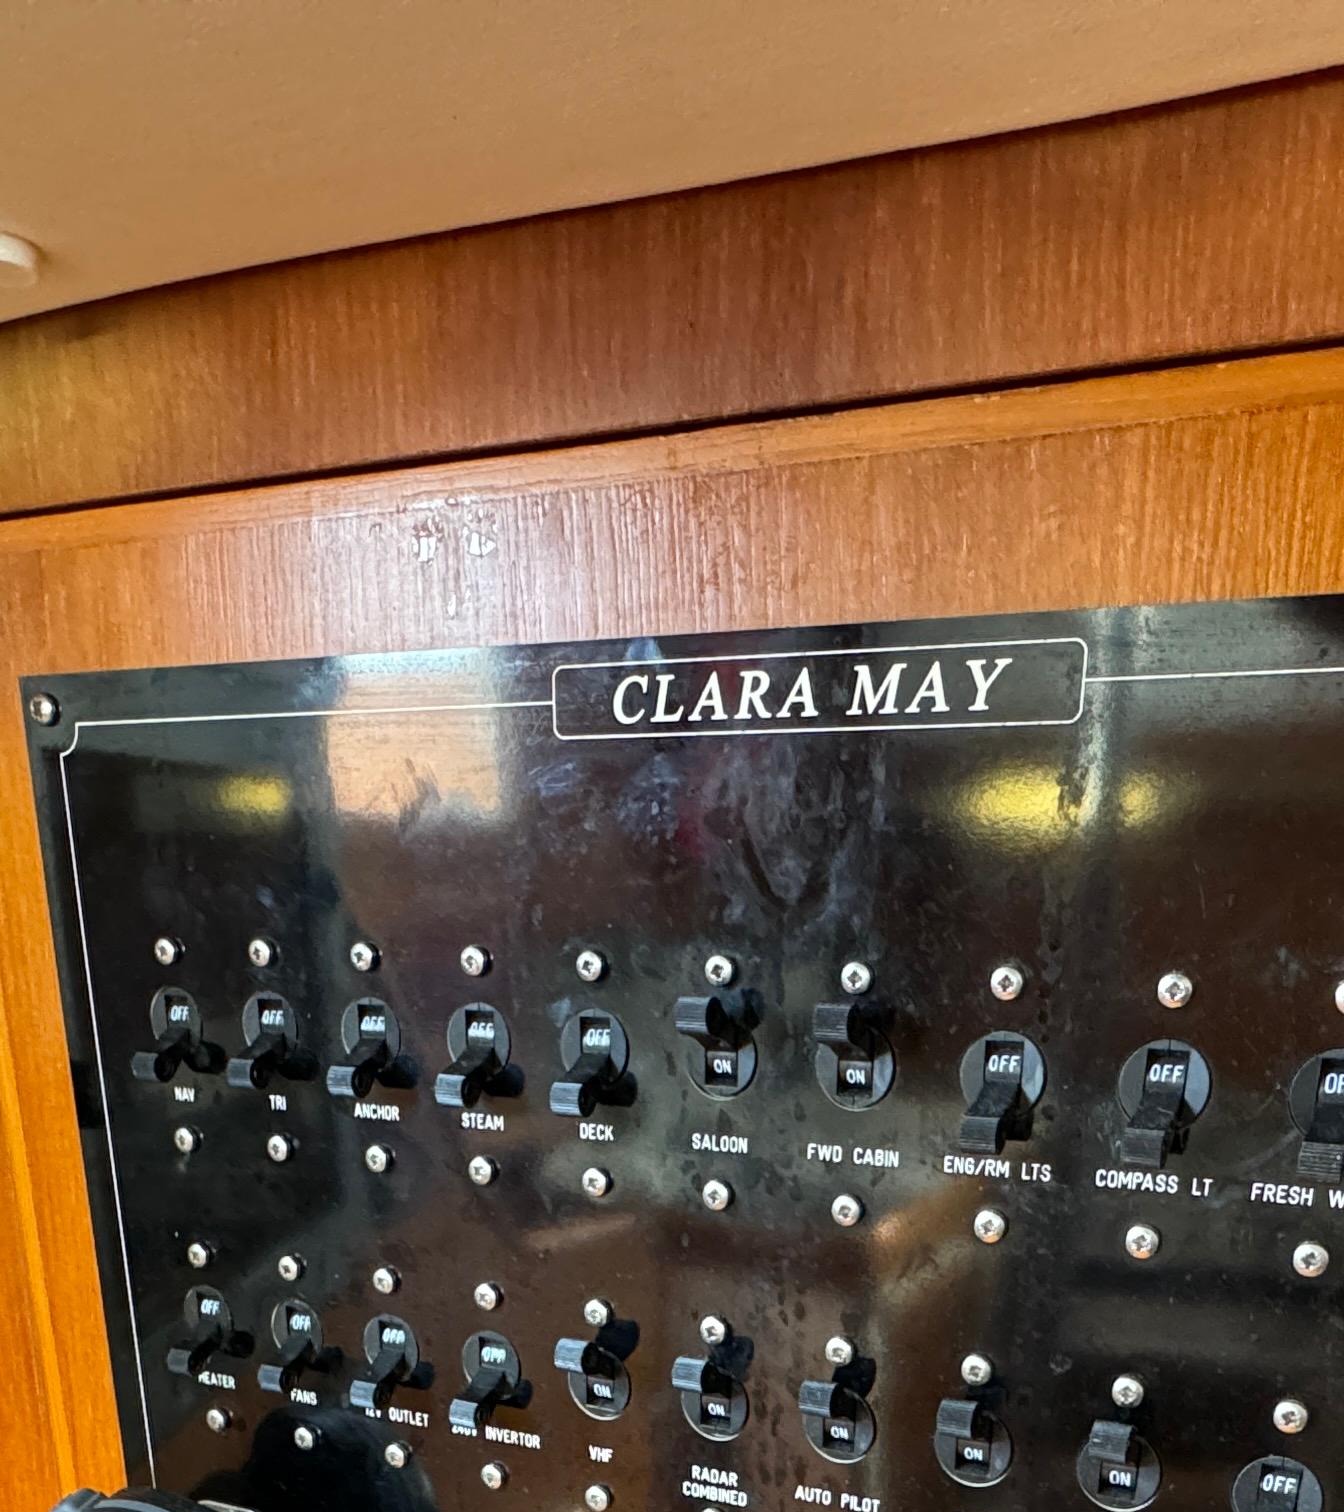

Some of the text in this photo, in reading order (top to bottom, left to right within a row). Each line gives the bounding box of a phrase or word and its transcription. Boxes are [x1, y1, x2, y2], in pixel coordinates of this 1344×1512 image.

[612, 657, 1013, 725] CLARA MAY
[170, 1005, 191, 1022] OFF
[261, 1010, 285, 1025] OFF
[360, 1015, 386, 1032] OFF
[467, 1021, 495, 1039] OFF
[583, 1028, 611, 1047] OFF
[713, 1058, 733, 1075] ON
[988, 1054, 1021, 1073] OFF
[1148, 1063, 1184, 1083] OFF
[845, 1068, 866, 1085] ON
[174, 1087, 195, 1102] NAV
[269, 1095, 287, 1111] TRI
[353, 1102, 400, 1122] ANCHOR
[461, 1113, 505, 1132] STEAM
[579, 1123, 615, 1141] DECK
[691, 1133, 749, 1155] SALOON
[807, 1143, 899, 1168] FWD CABIN
[943, 1155, 1052, 1183] ENG/RM LTS
[1095, 1169, 1214, 1197] COMPASS LT
[1250, 1182, 1314, 1207] FRESH
[200, 1298, 220, 1315] OFF
[198, 1371, 236, 1390] HEATER
[291, 1388, 318, 1406] FANS
[593, 1383, 612, 1399] ON
[388, 1407, 430, 1428] OUTLET
[708, 1402, 726, 1417] ON
[485, 1425, 541, 1450] INVERTOR
[830, 1425, 849, 1440] ON
[589, 1445, 614, 1463] VHF
[964, 1447, 983, 1461] ON
[691, 1464, 739, 1487] RADAR
[1109, 1470, 1131, 1488] ON
[1262, 1473, 1297, 1496] OFF
[682, 1481, 748, 1508] COMBINED
[794, 1484, 832, 1506] AUTO
